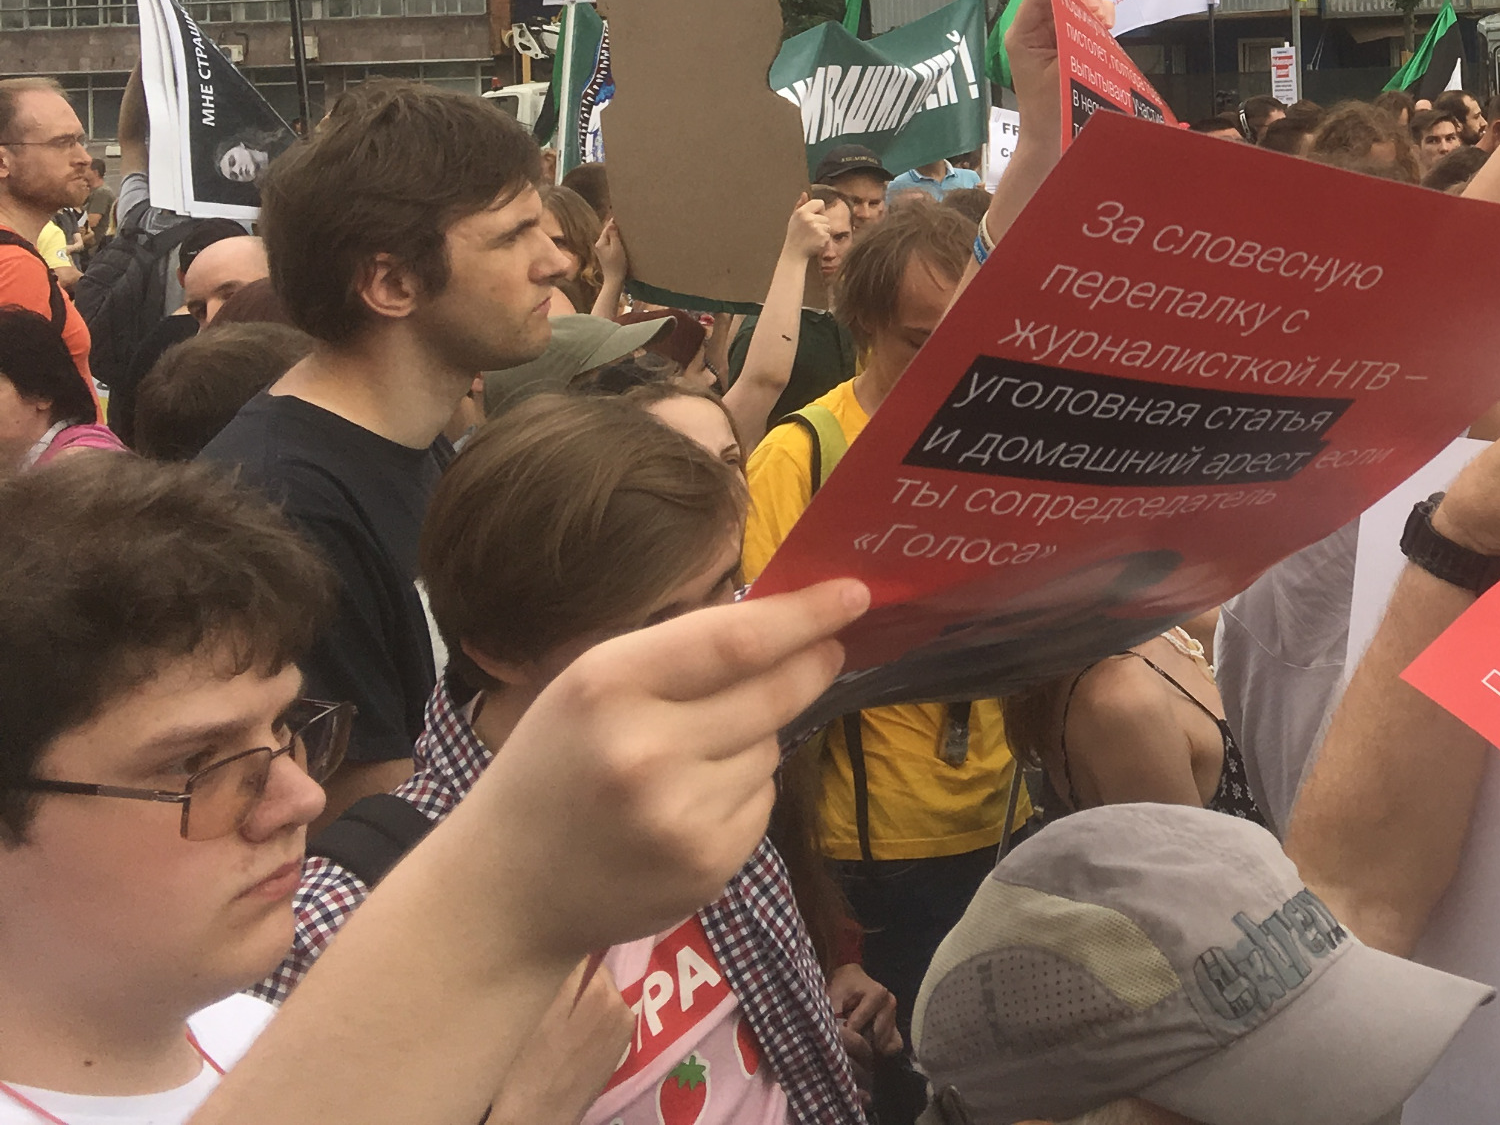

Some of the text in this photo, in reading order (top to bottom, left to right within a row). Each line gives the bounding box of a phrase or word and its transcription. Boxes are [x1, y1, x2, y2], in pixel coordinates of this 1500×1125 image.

[199, 83, 216, 127] МНЕ
[1070, 56, 1132, 108] выпытывают
[1072, 88, 1080, 107] в
[1082, 200, 1385, 293] За словесную
[1040, 263, 1311, 337] перепалку с
[997, 318, 1320, 388] журналисткой
[1315, 358, 1402, 391] НТВ
[952, 372, 1334, 433] уголовная статья
[922, 426, 962, 454] и
[958, 432, 1206, 475] домашний
[1315, 446, 1396, 470] если
[892, 478, 1278, 527] ты сопредседатель
[853, 523, 1057, 566] «Голоса»
